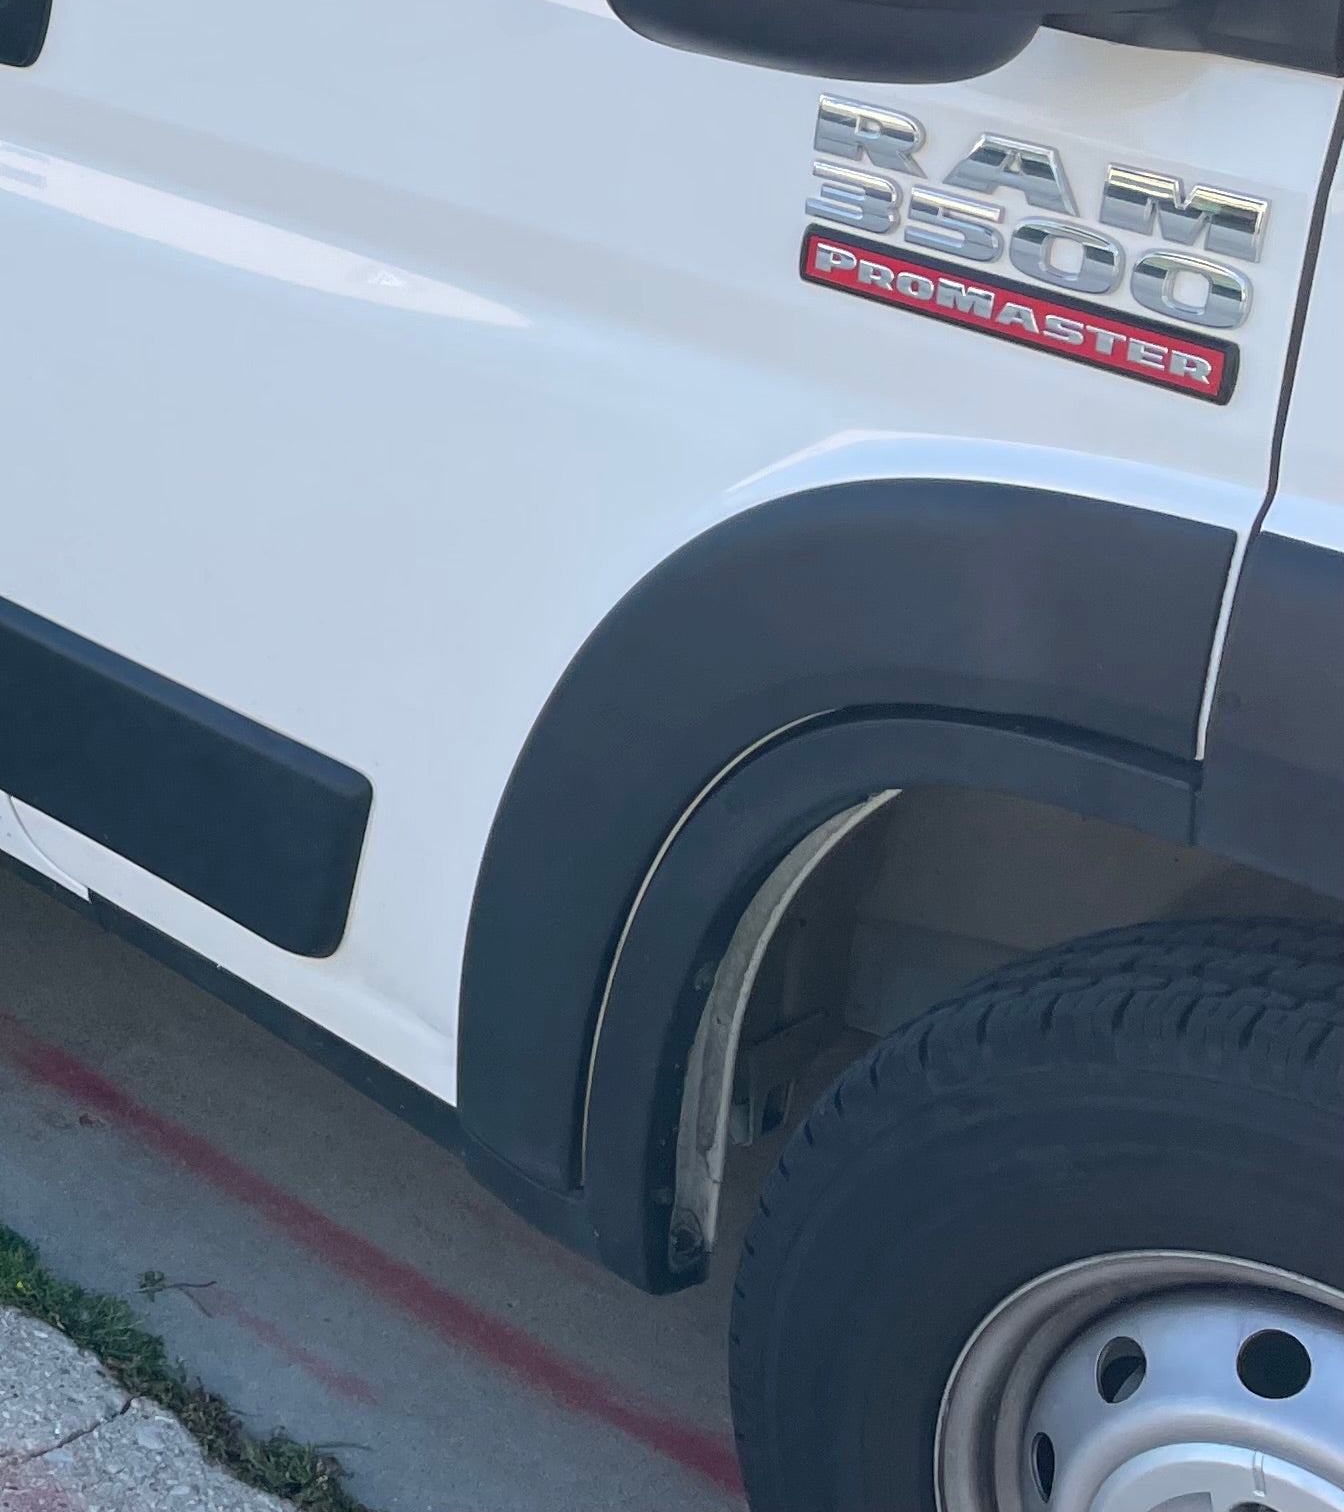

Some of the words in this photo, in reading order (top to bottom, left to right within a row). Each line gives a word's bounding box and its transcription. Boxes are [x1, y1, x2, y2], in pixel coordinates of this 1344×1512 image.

[805, 161, 1252, 330] 3500
[813, 92, 1273, 263] RAM
[814, 242, 1212, 385] PROMASTER
